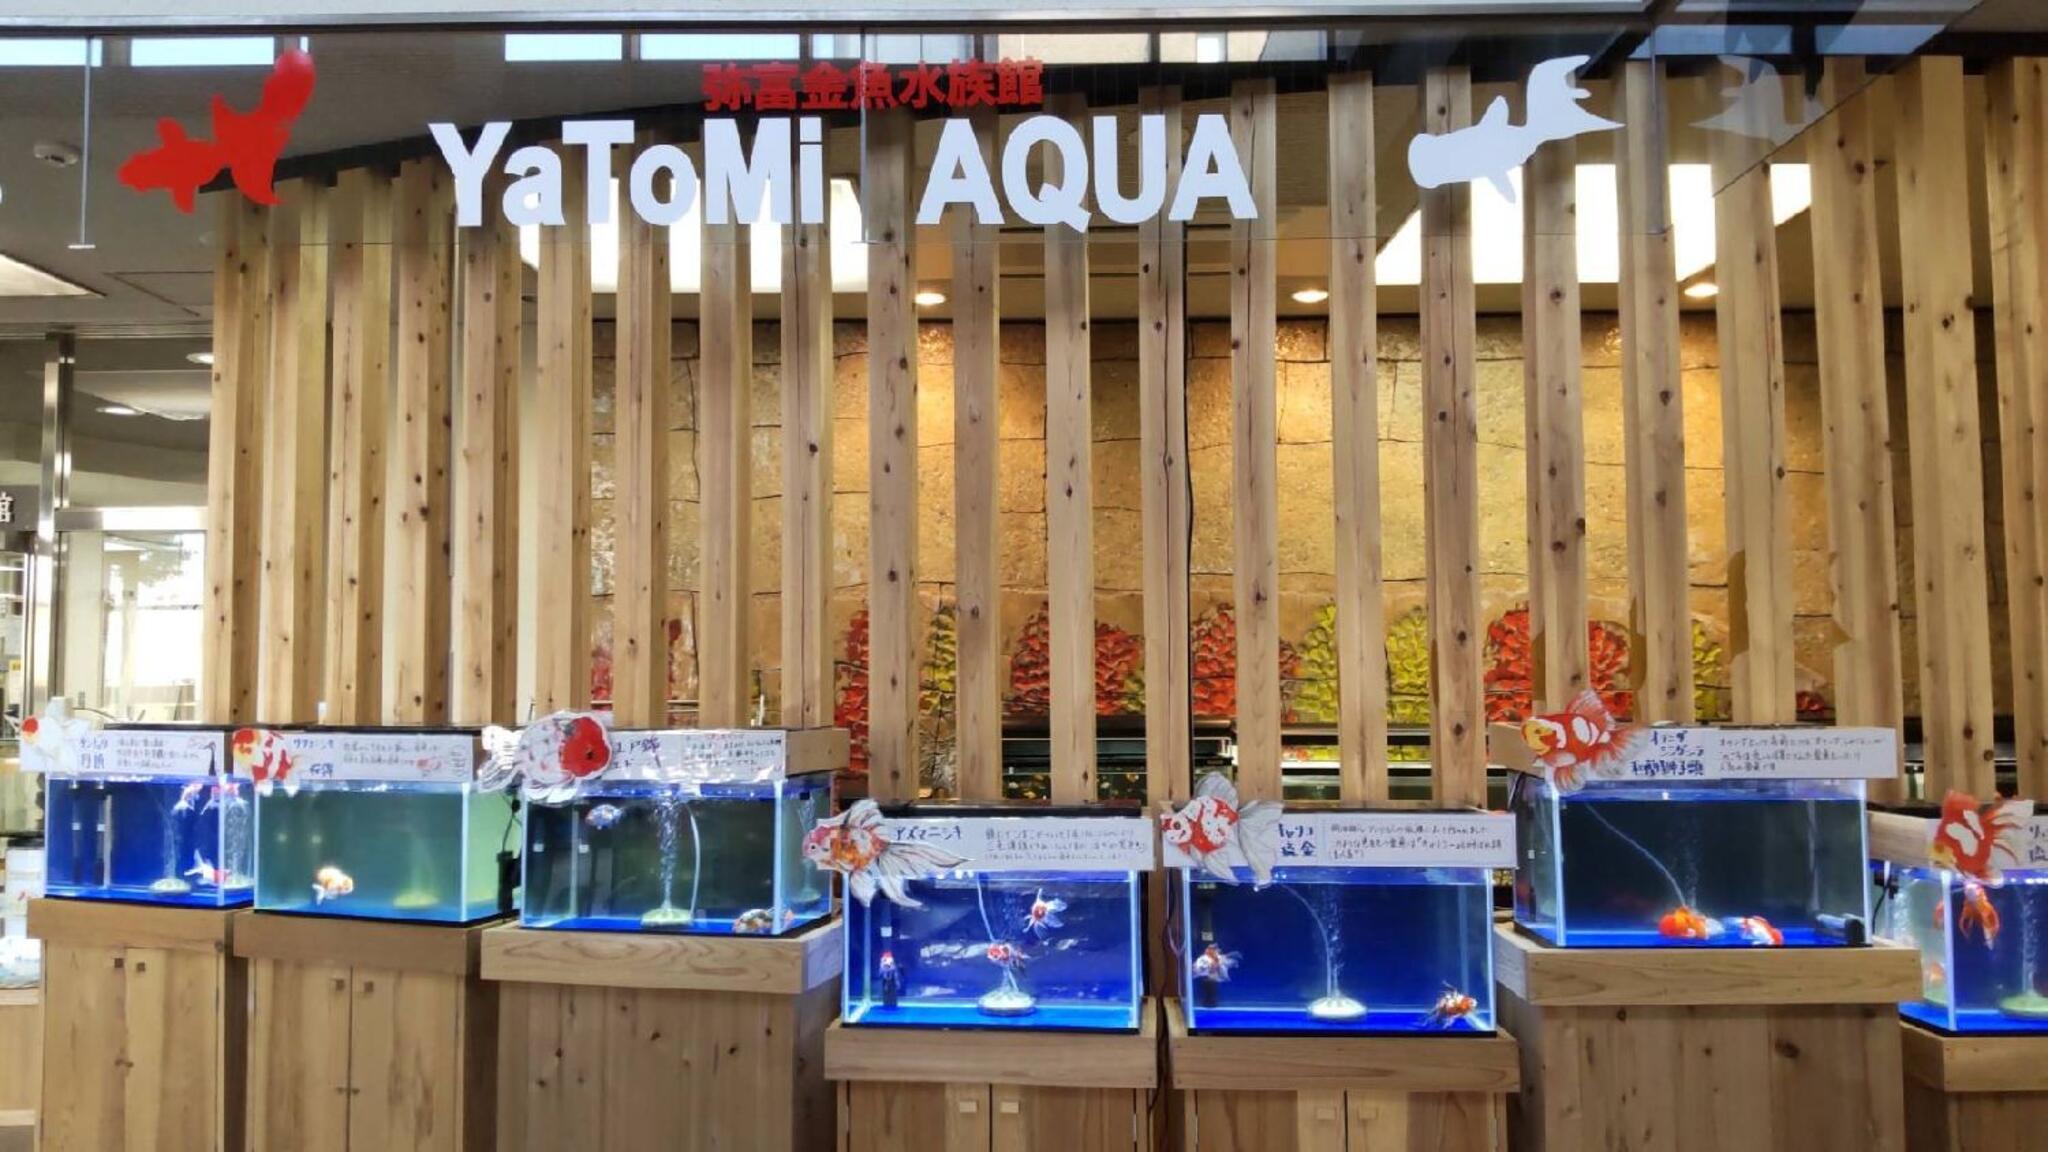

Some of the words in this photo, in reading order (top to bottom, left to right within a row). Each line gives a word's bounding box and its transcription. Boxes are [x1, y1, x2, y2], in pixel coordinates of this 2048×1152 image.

[702, 56, 1044, 111] 弥富金魚水族館
[428, 117, 824, 227] YaToMi
[915, 114, 1258, 233] AQUA
